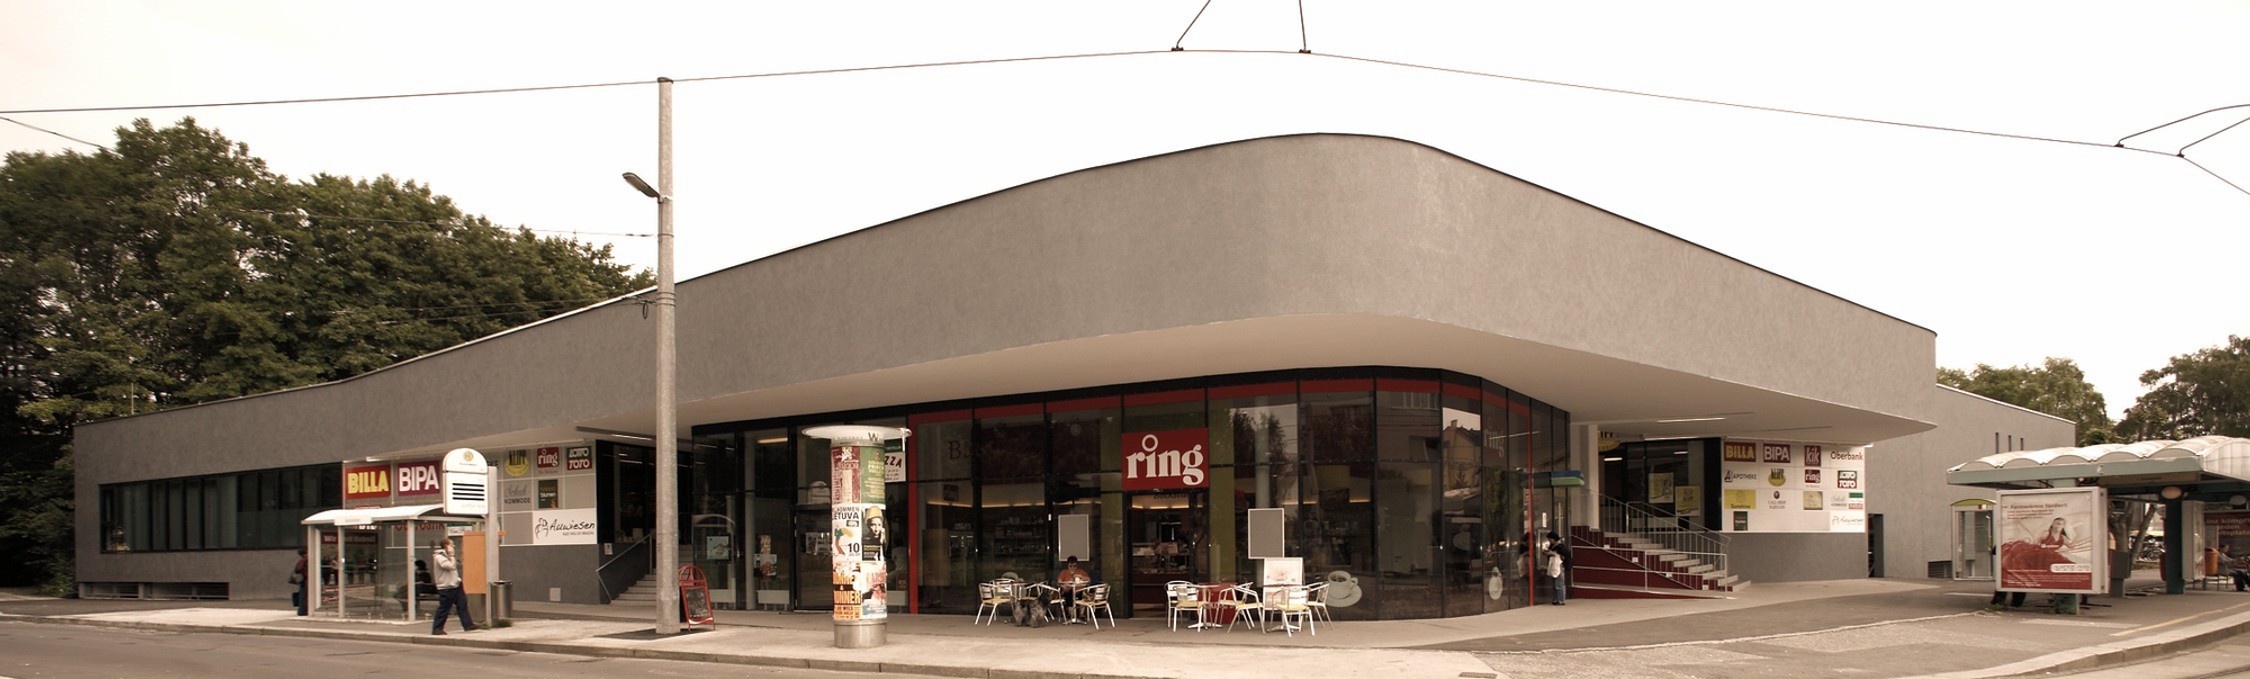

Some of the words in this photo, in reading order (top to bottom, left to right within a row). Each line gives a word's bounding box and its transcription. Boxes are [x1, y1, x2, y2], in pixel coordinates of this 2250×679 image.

[538, 449, 559, 467] ring
[1725, 445, 1755, 459] BILLA
[1764, 445, 1790, 461] BIPA
[1806, 446, 1820, 464] kik
[1831, 451, 1863, 460] Oberbank
[569, 459, 590, 469] TOTO
[884, 455, 903, 468] ZZA
[1126, 434, 1204, 486] ring
[347, 470, 389, 494] BILLA
[399, 465, 440, 492] BIPA
[550, 519, 595, 531] Auwiesen
[848, 543, 860, 553] 10
